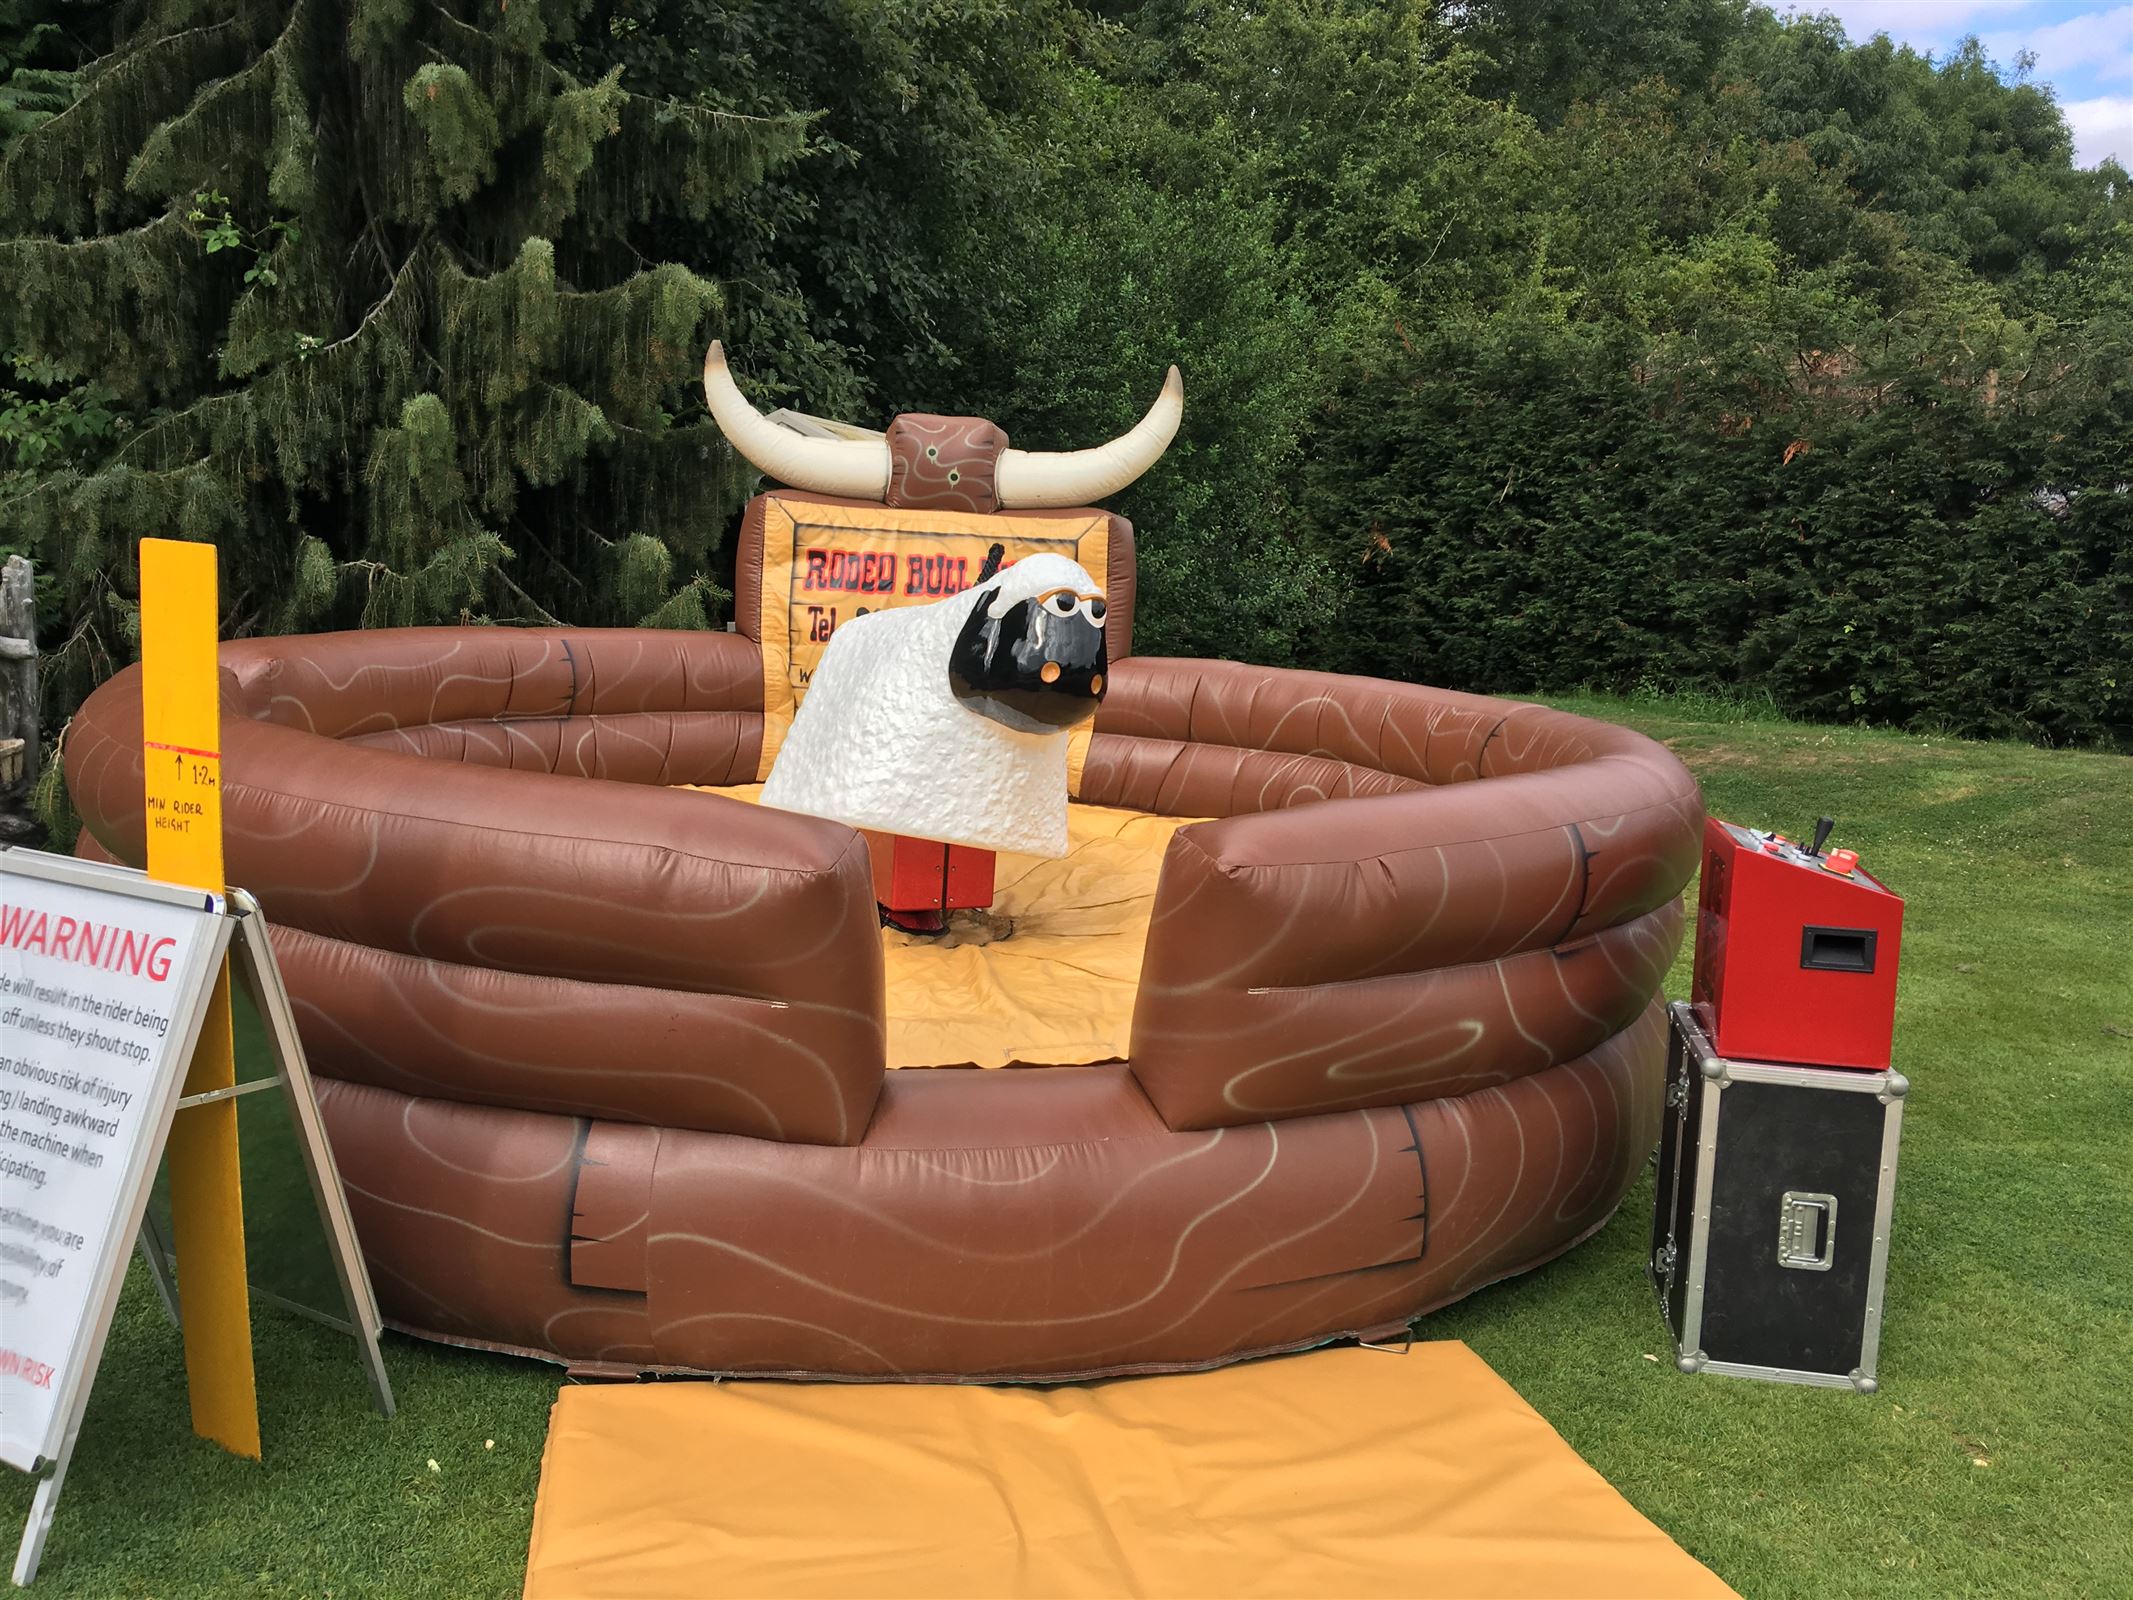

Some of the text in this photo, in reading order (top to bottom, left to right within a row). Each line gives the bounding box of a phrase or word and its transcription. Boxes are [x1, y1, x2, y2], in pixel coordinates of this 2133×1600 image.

[803, 547, 973, 597] RODEO BULL
[147, 796, 203, 816] MIN RIDER
[155, 816, 190, 833] HEIGHT
[0, 904, 177, 982] WARNING
[12, 978, 35, 997] will
[33, 985, 67, 1007] result
[66, 989, 80, 1008] in
[81, 994, 102, 1016] the
[103, 999, 133, 1023] rider
[133, 1006, 169, 1038] being
[2, 1007, 151, 1066] off unless they shout stop.
[13, 1057, 59, 1086] obvious
[59, 1069, 80, 1093] risk
[81, 1077, 99, 1095] of
[96, 1079, 133, 1112] injury
[18, 1090, 62, 1127] landing
[62, 1108, 120, 1138] awkward
[0, 1119, 104, 1169] the machine when
[63, 1230, 85, 1251] are
